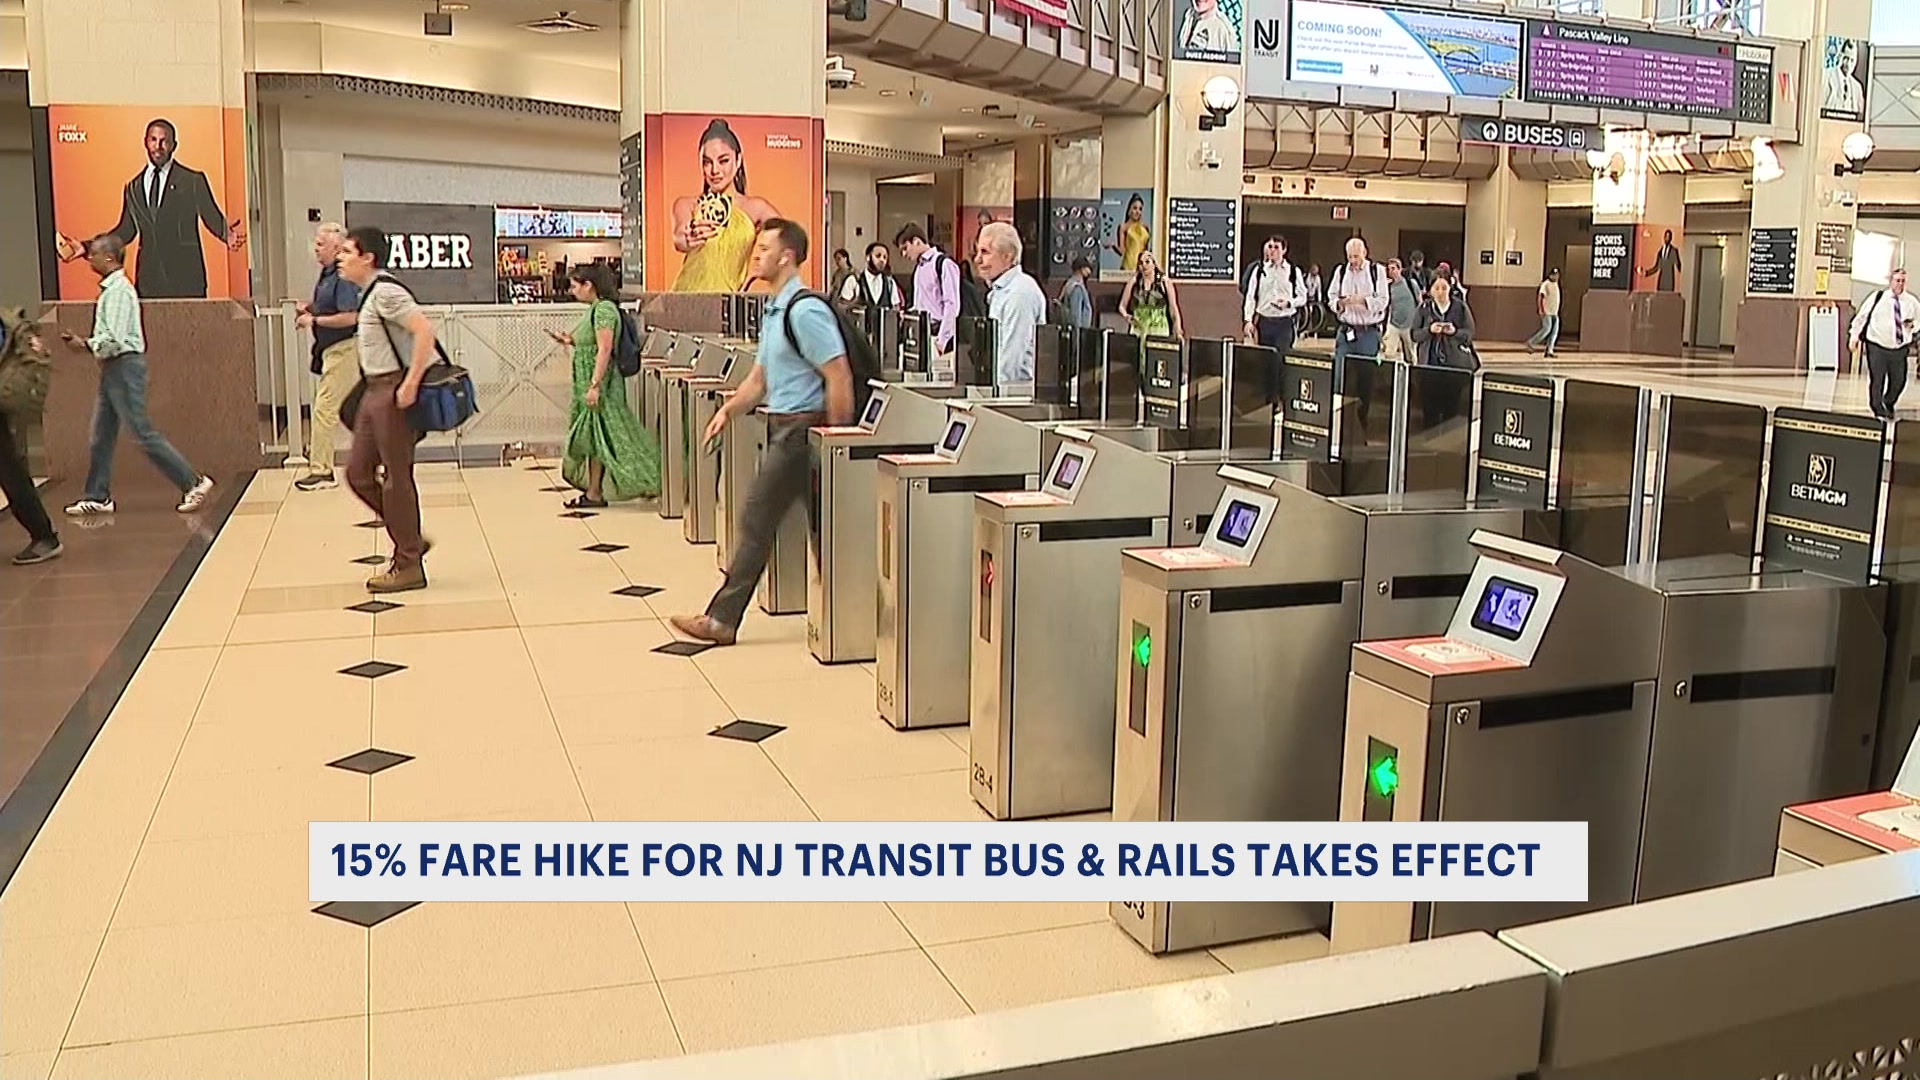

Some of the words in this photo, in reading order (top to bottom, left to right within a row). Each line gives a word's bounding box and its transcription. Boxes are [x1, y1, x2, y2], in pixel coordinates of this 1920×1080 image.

[1297, 20, 1344, 34] COMING
[1347, 25, 1382, 38] SOON!
[1559, 27, 1589, 40] Pascack
[1590, 31, 1612, 44] Valley
[1613, 33, 1629, 45] Line
[58, 131, 87, 142] FOXX
[1504, 124, 1563, 146] BUSES
[767, 140, 801, 148] HUDGENS
[1271, 176, 1283, 194] E
[1303, 177, 1316, 195] F
[1594, 235, 1623, 245] SPORTS
[384, 234, 473, 268] ABER
[1594, 246, 1627, 257] BETTORS
[1594, 257, 1619, 267] BOARD
[1593, 268, 1611, 278] HERE
[1494, 433, 1532, 450] BETMGM
[1791, 484, 1847, 506] BETMGM
[974, 762, 993, 794] 2B-4
